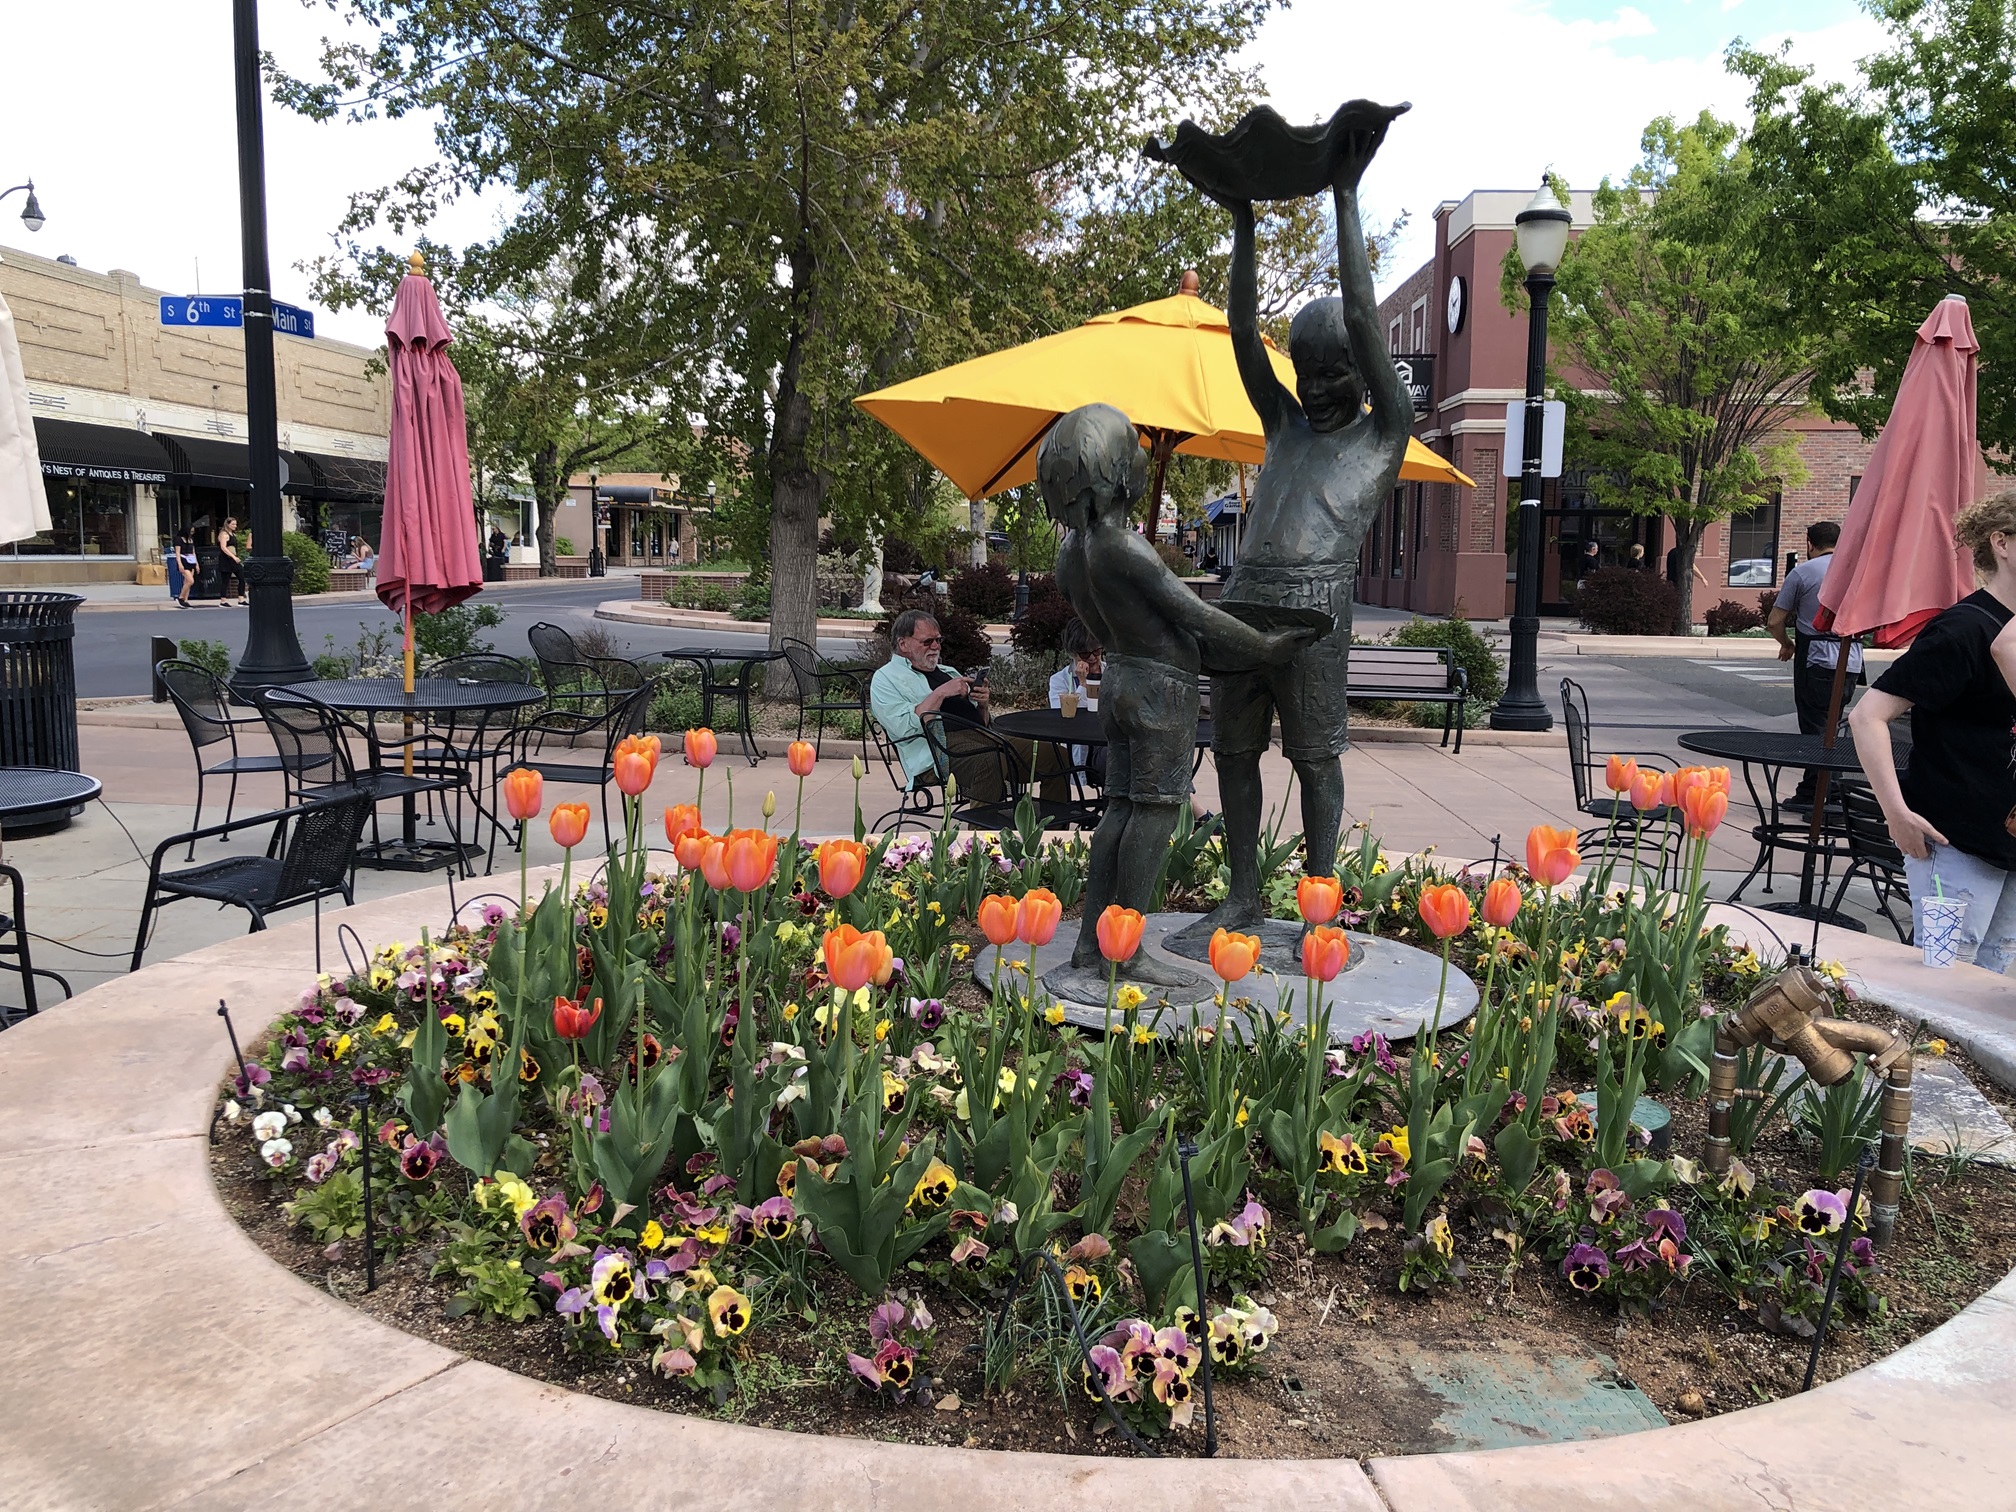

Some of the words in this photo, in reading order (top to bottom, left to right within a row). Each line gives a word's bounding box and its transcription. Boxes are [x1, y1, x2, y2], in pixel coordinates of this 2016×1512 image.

[167, 304, 175, 317] S
[186, 300, 210, 323] 6th
[223, 307, 236, 319] St
[271, 306, 298, 333] Main
[303, 319, 312, 331] St
[52, 464, 73, 476] NEST
[75, 468, 86, 477] OF
[89, 467, 122, 480] ANTIQUES
[123, 470, 130, 480] &
[131, 470, 166, 482] TREASURES
